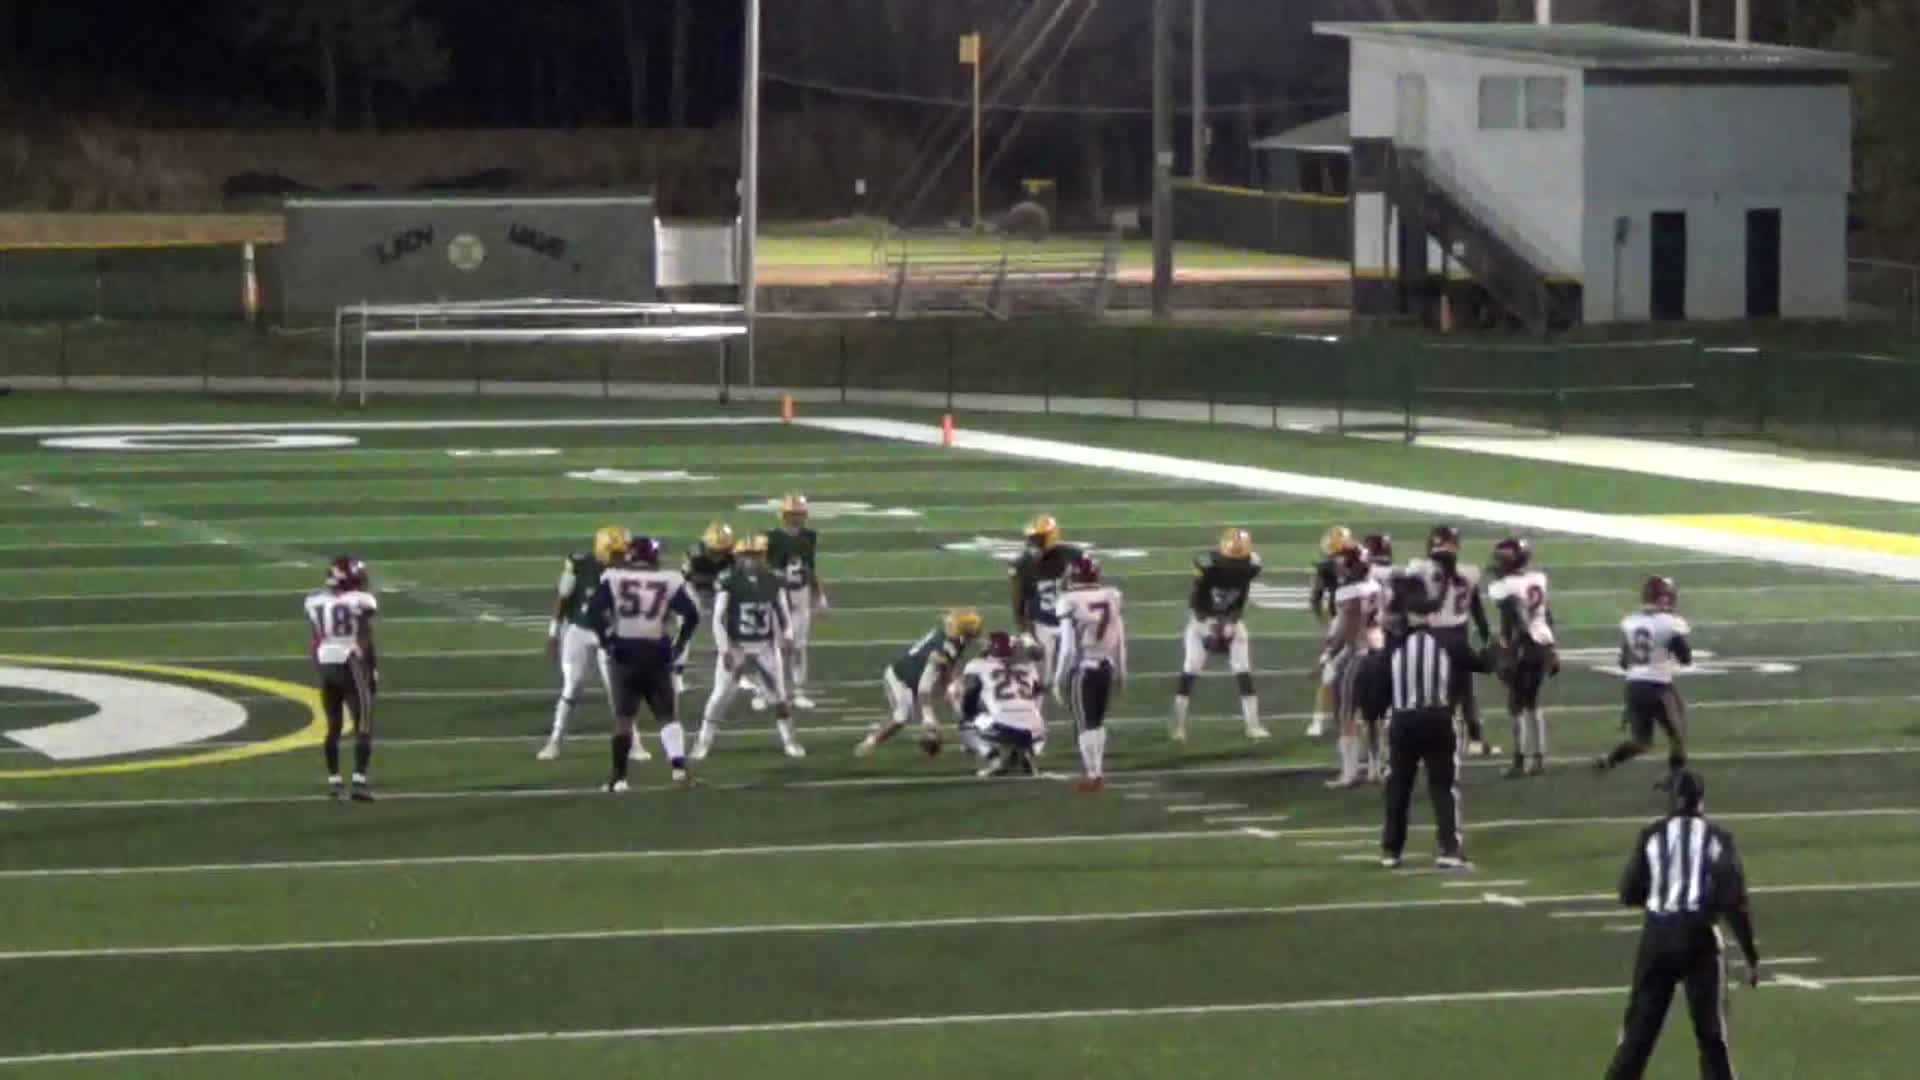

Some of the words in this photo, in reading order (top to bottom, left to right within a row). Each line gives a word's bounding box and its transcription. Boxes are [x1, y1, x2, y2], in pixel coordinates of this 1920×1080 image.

[618, 579, 668, 619] 57
[313, 604, 353, 637] 18
[738, 601, 774, 635] 53
[1087, 601, 1110, 640] 7
